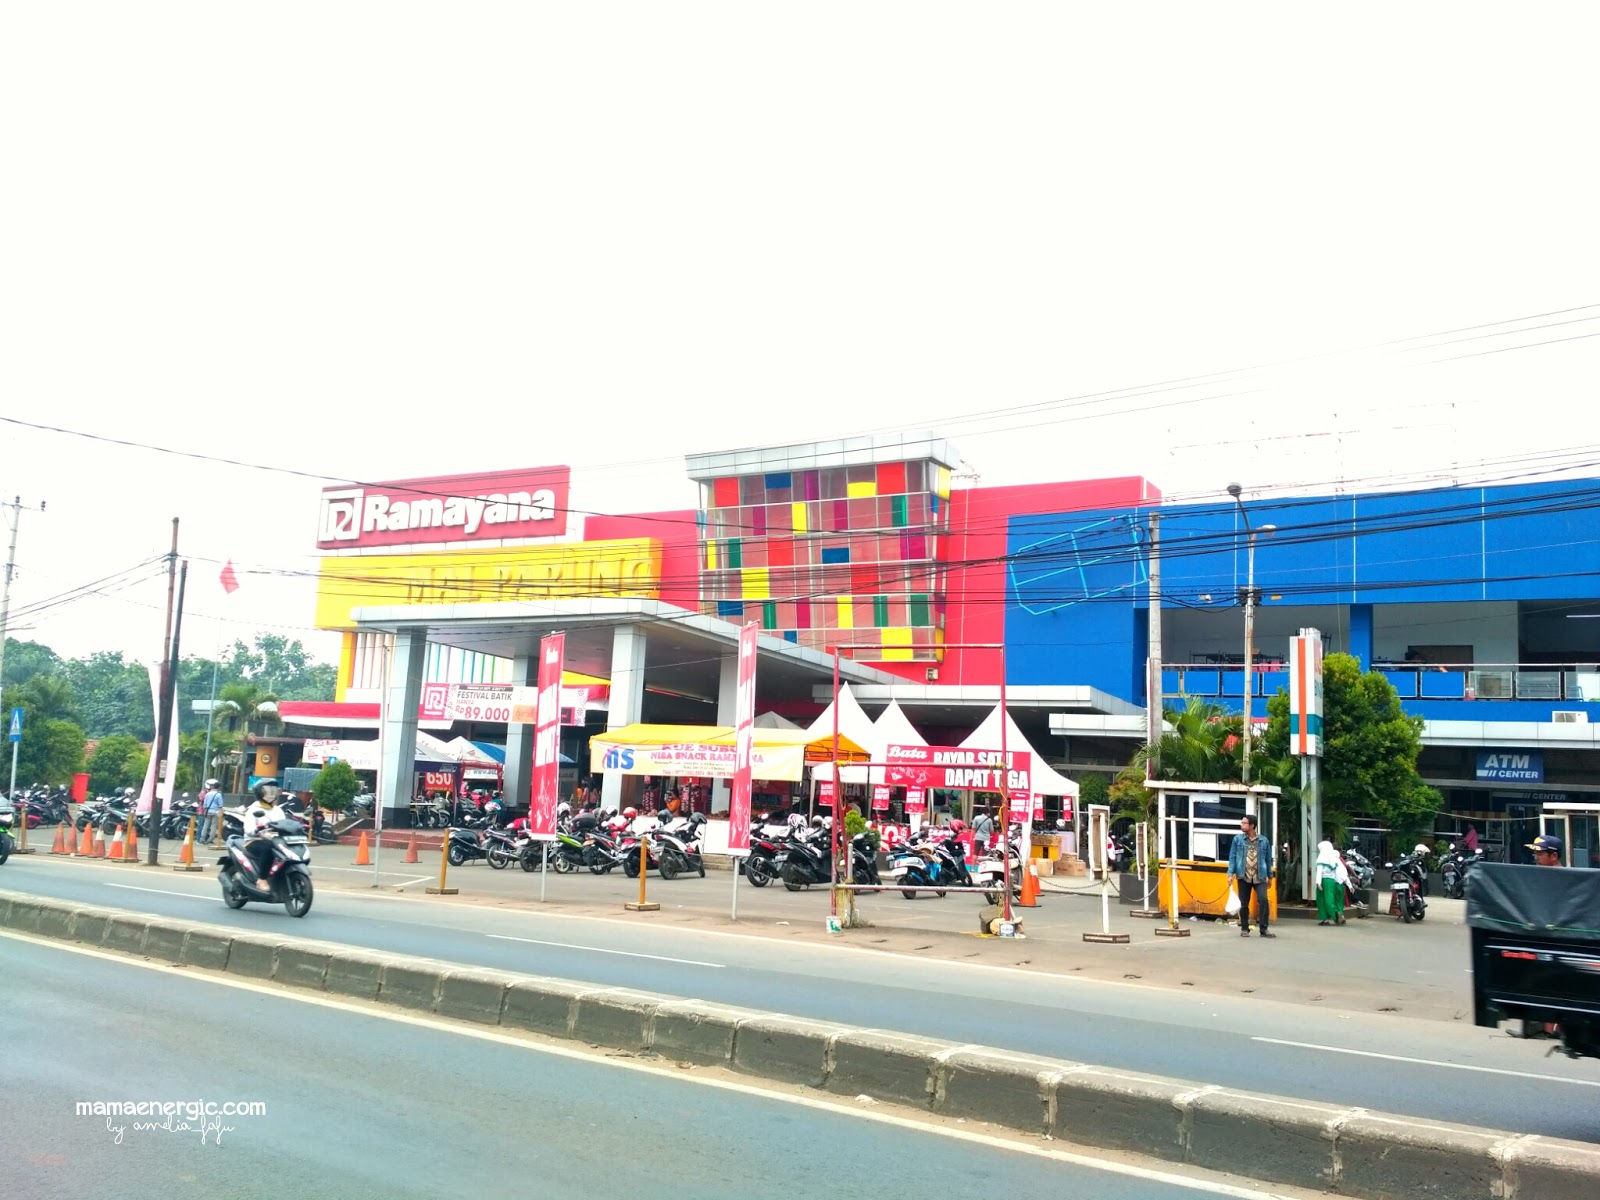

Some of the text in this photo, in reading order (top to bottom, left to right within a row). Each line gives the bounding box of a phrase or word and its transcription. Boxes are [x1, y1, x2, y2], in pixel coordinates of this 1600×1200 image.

[362, 488, 555, 534] Ramayana
[457, 691, 513, 701] FESTIVAL BATIK
[887, 746, 928, 760] Bata
[1484, 754, 1530, 769] ATM
[944, 768, 1029, 790] DAPAT TGA
[1498, 770, 1539, 779] CENTER
[1532, 792, 1566, 801] CENTER
